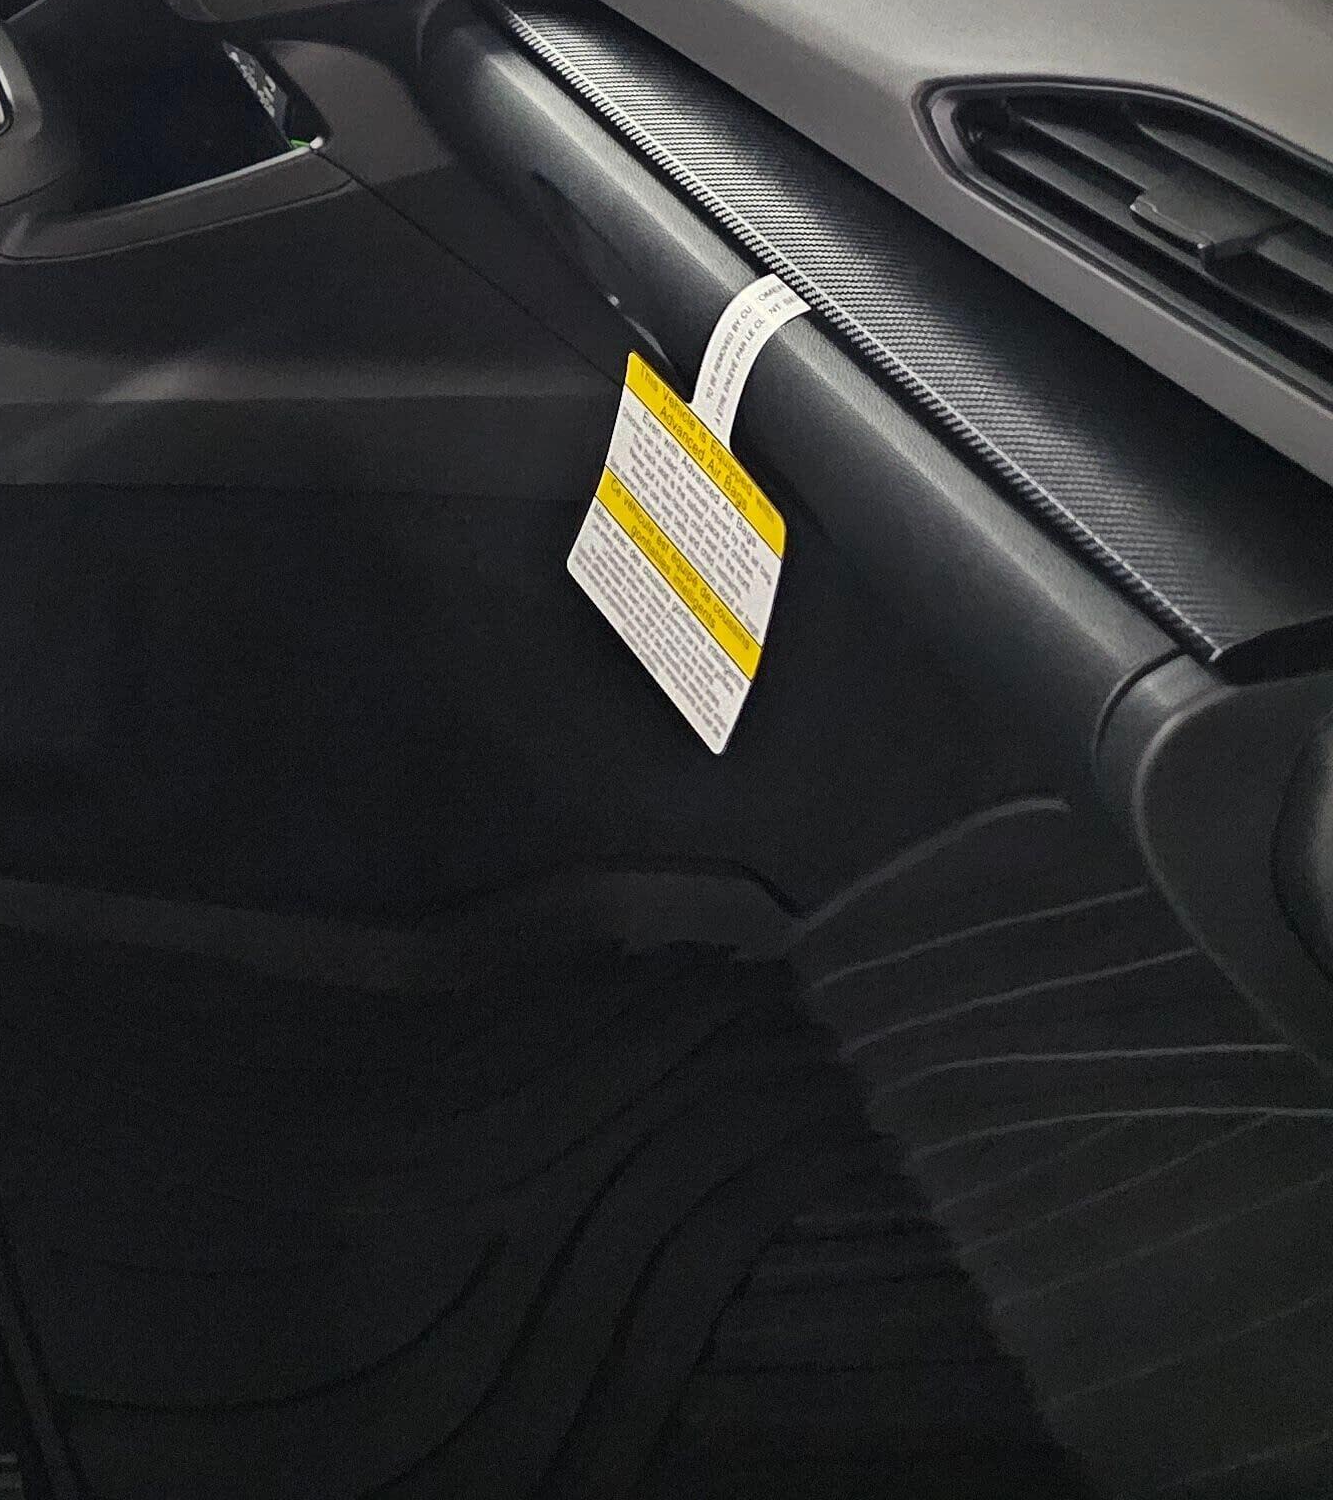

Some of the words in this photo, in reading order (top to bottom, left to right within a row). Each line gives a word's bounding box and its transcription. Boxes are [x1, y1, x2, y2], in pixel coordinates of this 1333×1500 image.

[639, 364, 659, 393] This
[661, 385, 697, 432] Vehicle
[708, 438, 754, 499] Equipped
[659, 403, 705, 463] Advanced
[707, 457, 721, 480] Air
[722, 476, 748, 514] Bags
[664, 434, 680, 459] with
[681, 454, 720, 506] Advanced
[721, 500, 734, 520] Air
[610, 478, 622, 499] Ce
[622, 493, 655, 538] véhicule
[655, 532, 669, 556] est
[669, 549, 698, 590] équipé
[698, 584, 711, 606] de
[712, 600, 750, 652] coussins
[630, 520, 671, 577] gonflables
[671, 569, 716, 631] intelligents
